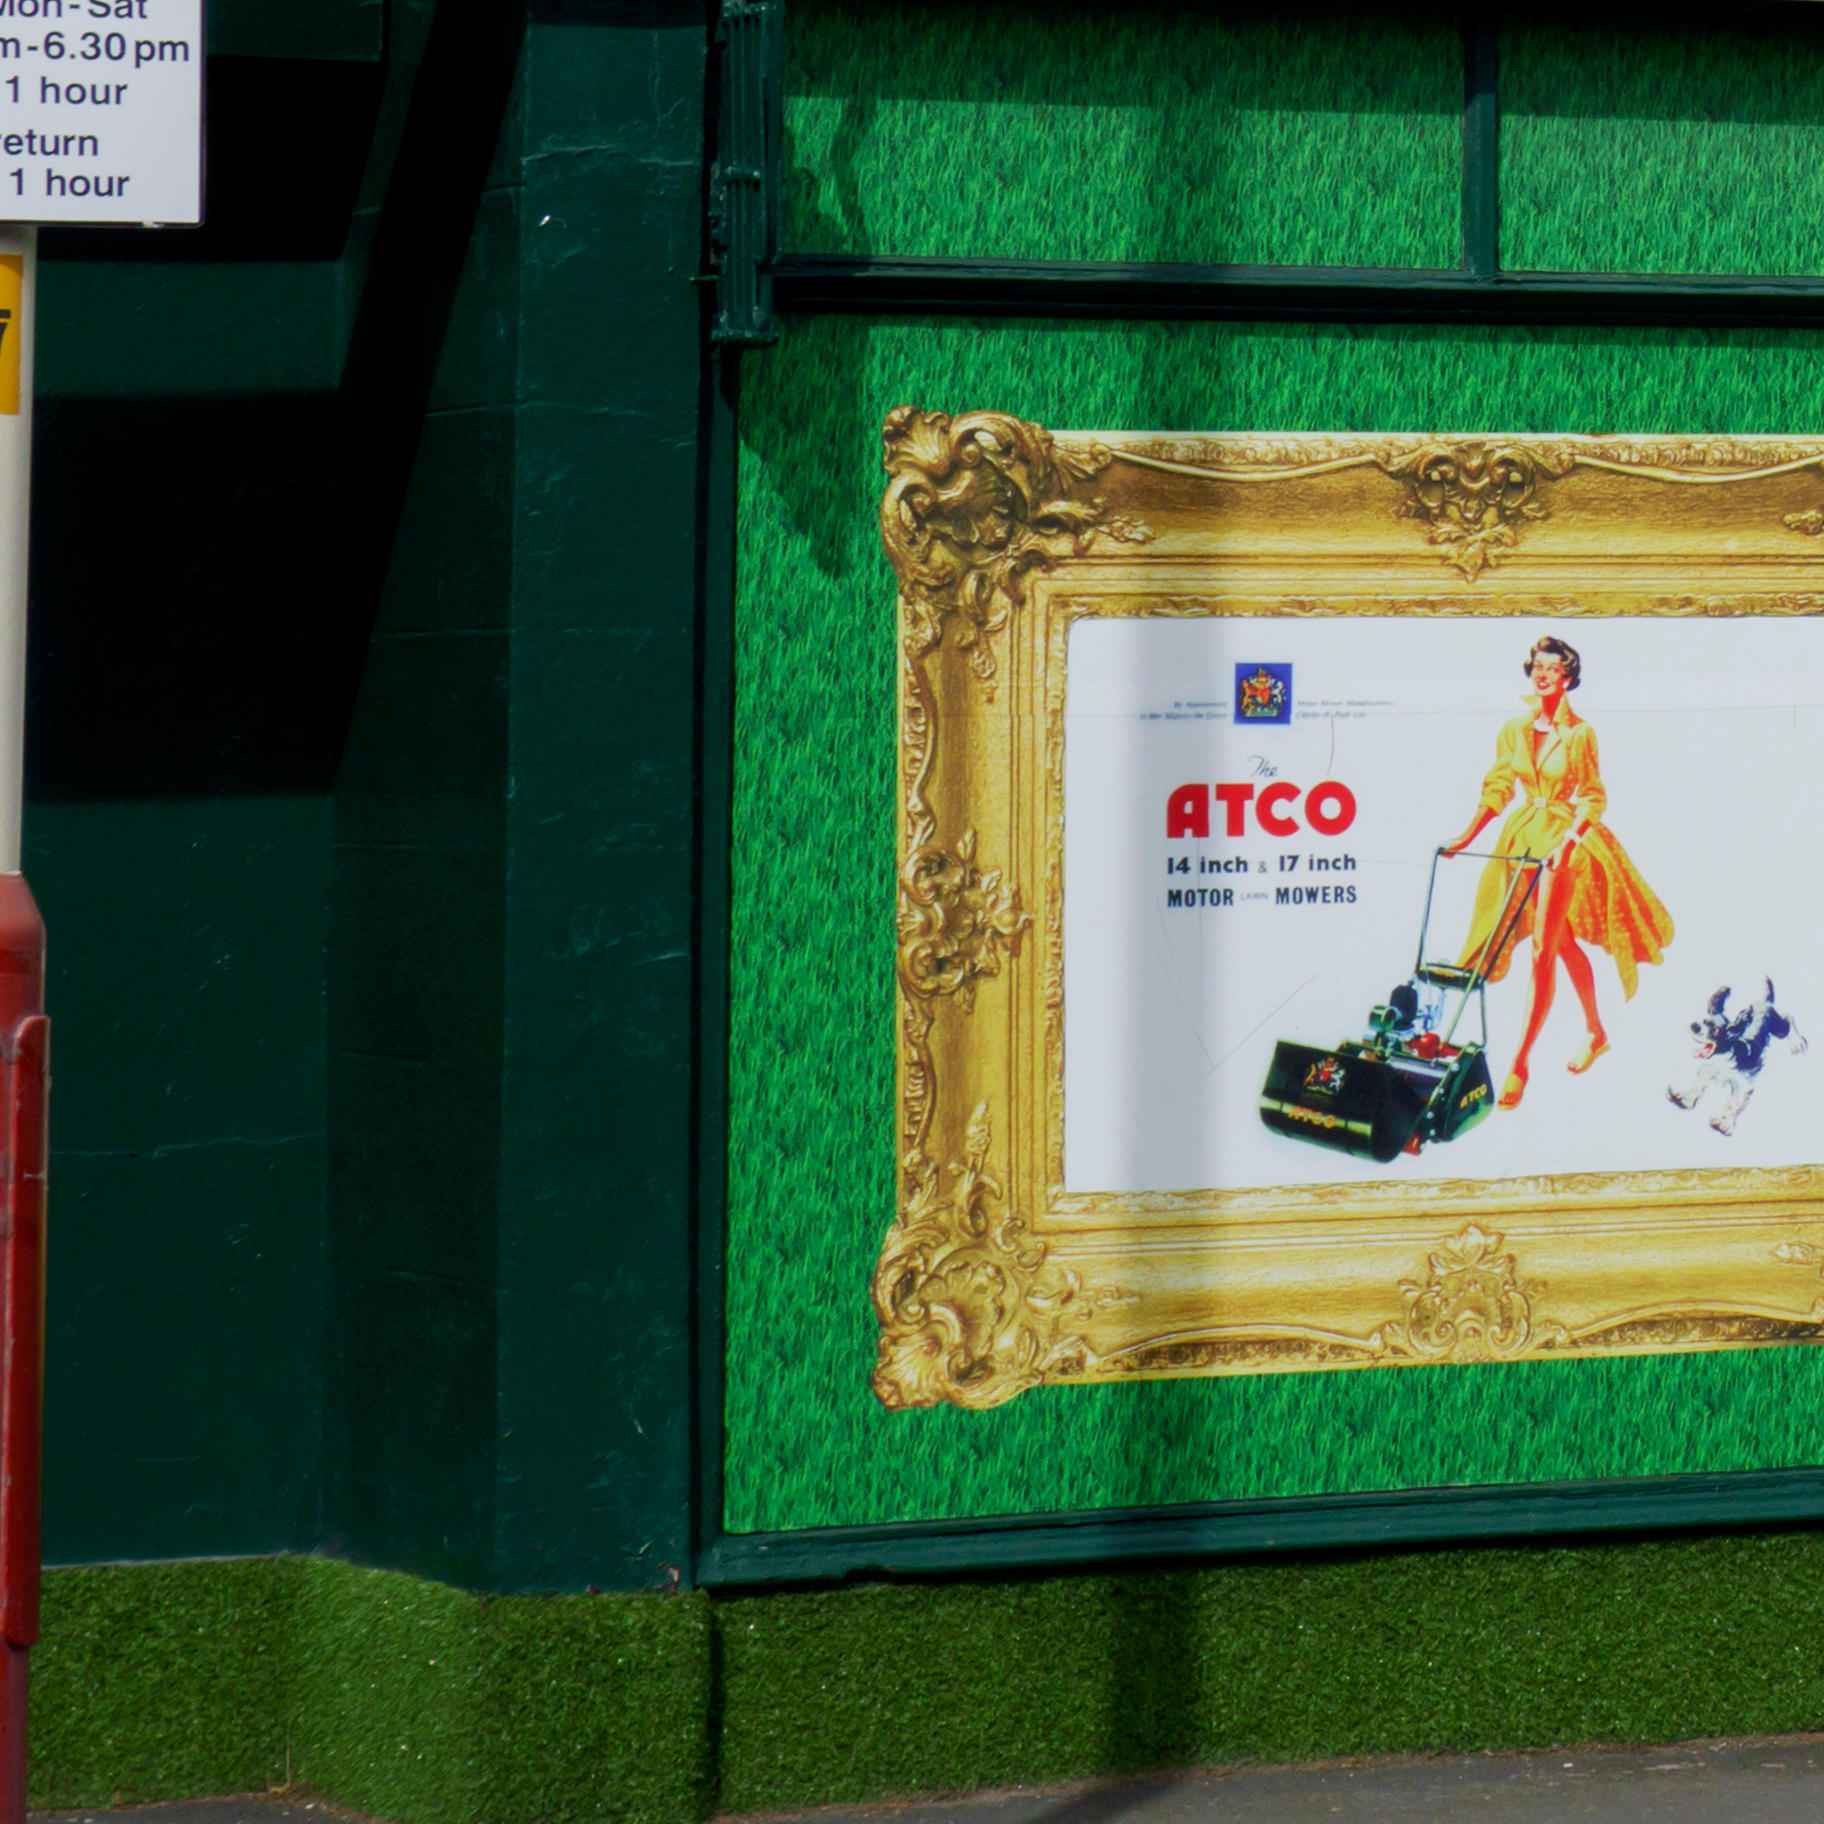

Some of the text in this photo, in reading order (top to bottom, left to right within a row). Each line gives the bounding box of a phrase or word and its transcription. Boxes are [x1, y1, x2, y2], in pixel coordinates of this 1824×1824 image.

[6, 76, 128, 104] 1 hour
[0, 129, 99, 156] eturn
[10, 168, 130, 197] 1 hour
[1166, 780, 1357, 839] ATCO
[1167, 857, 1191, 875] 14
[1200, 856, 1248, 873] inch
[1279, 855, 1299, 872] 17
[1308, 854, 1356, 871] inch
[1167, 888, 1234, 908] MOTOR
[1275, 885, 1357, 905] MOWERS
[1459, 1083, 1488, 1109] ATCO
